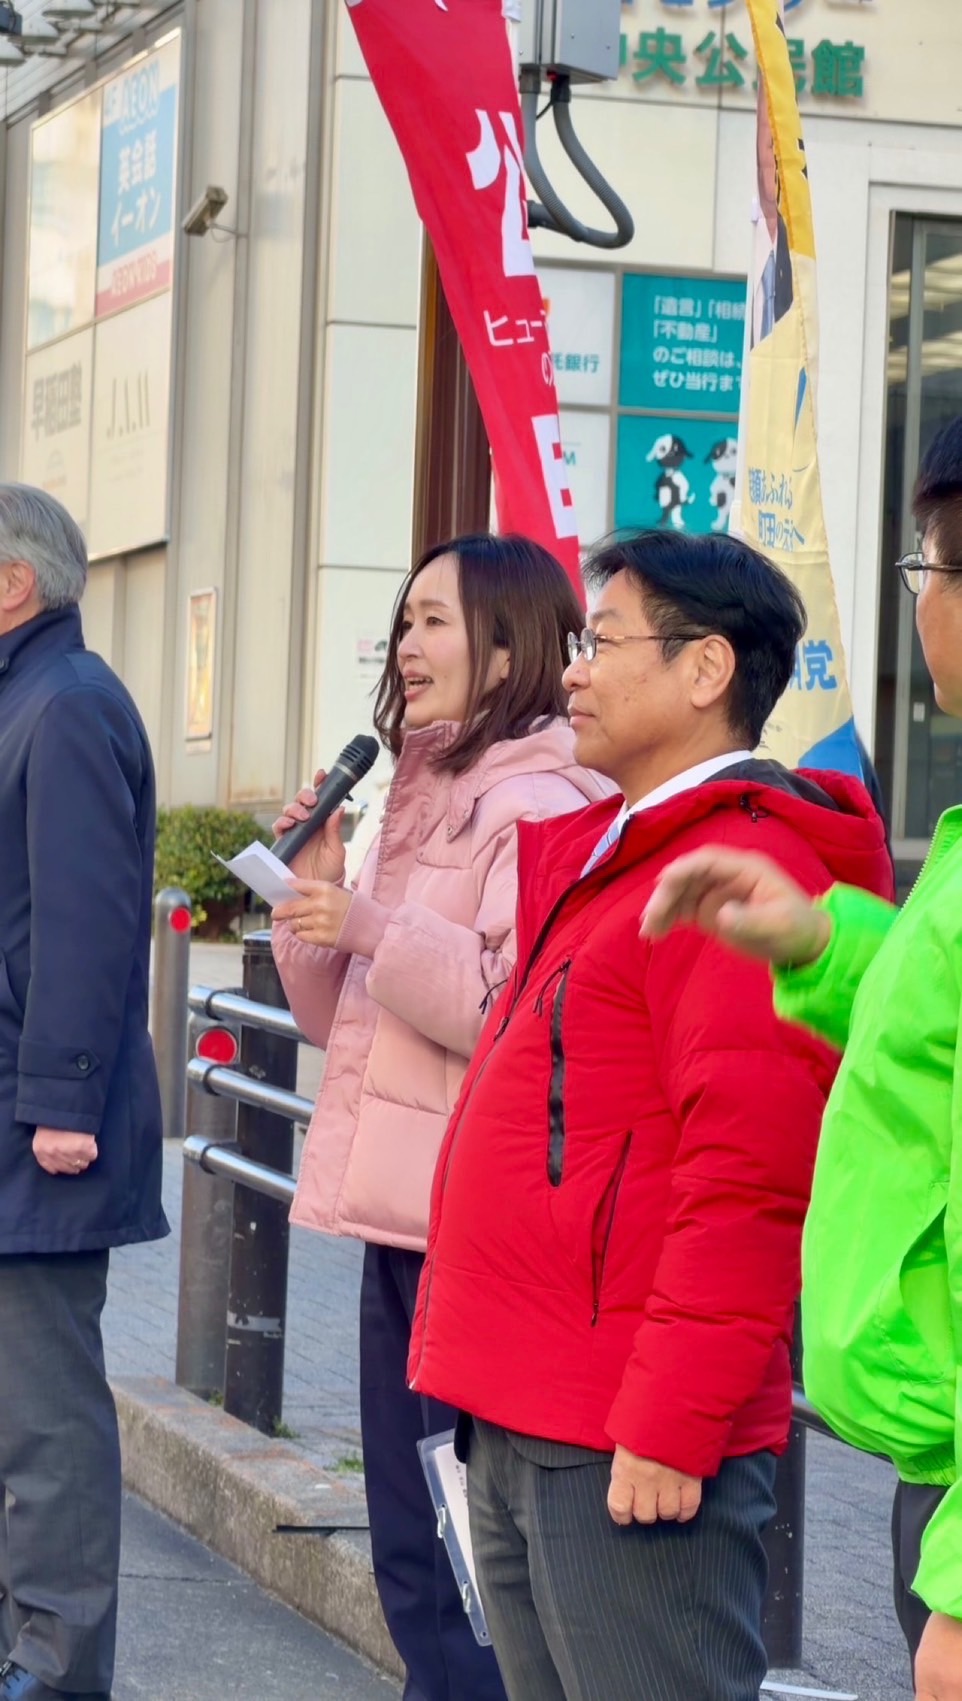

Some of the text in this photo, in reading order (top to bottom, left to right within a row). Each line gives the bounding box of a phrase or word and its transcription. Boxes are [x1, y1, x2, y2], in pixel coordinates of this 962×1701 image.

[618, 27, 865, 97] 央公館
[117, 131, 157, 196] 英会話
[111, 187, 161, 247] イーオン
[483, 308, 545, 347] ヒュー
